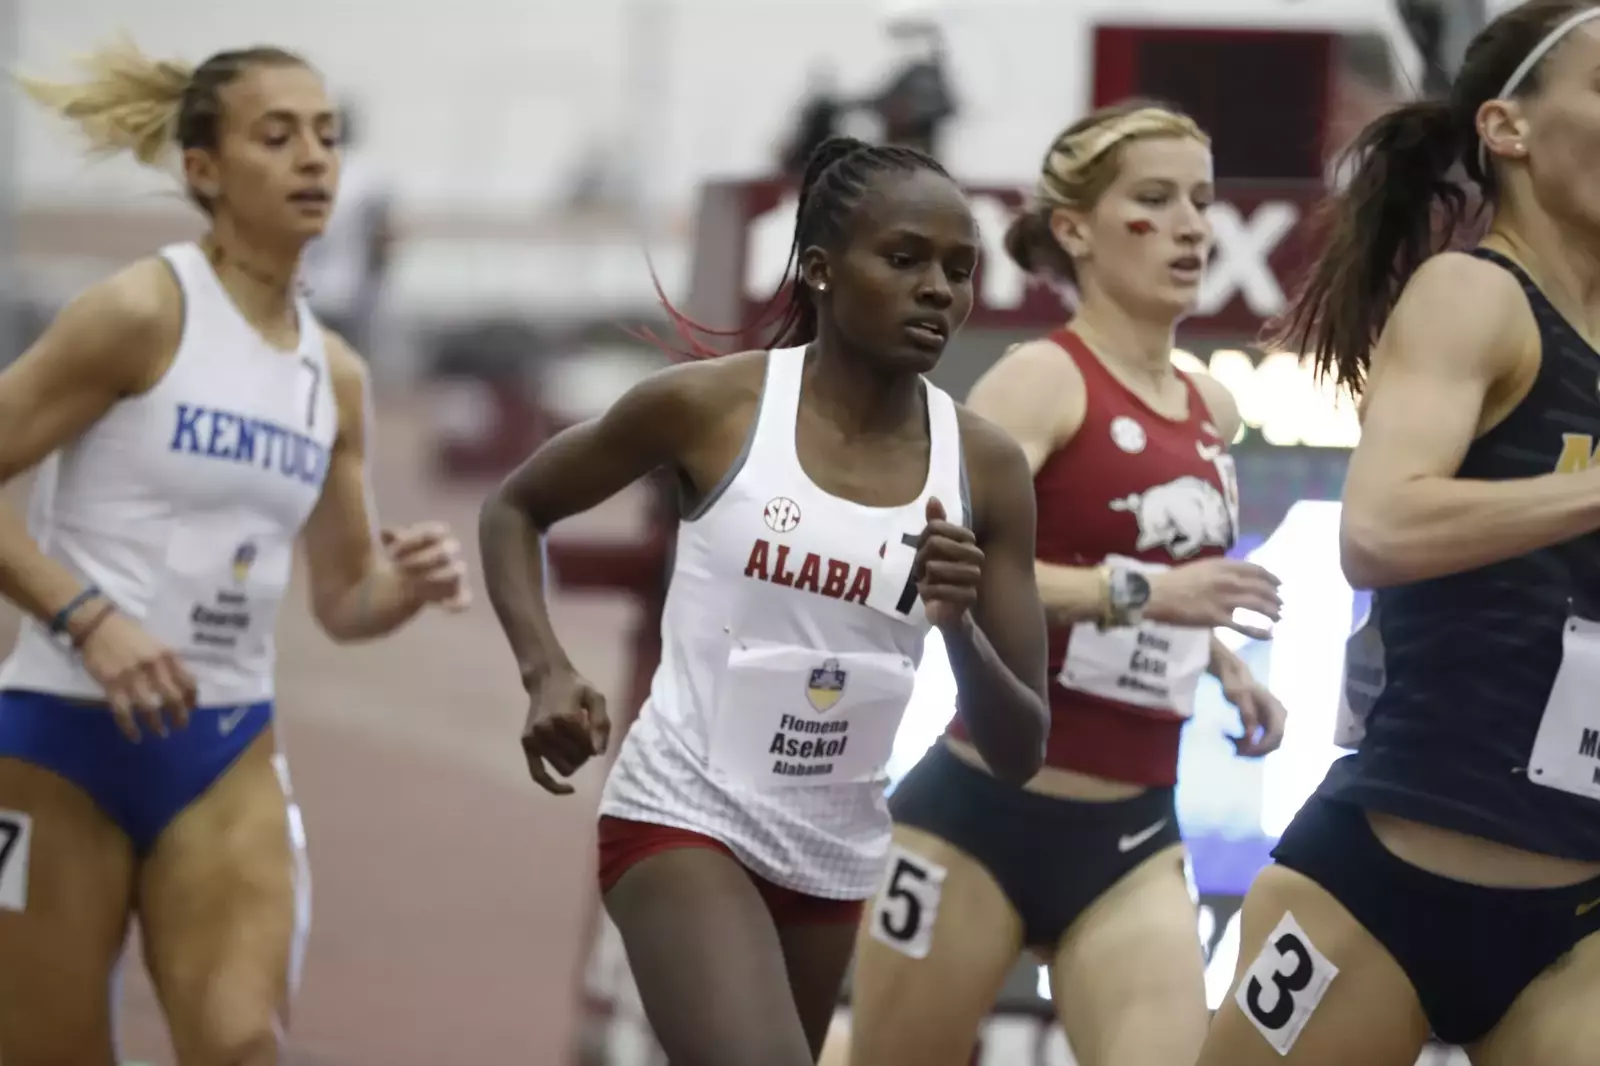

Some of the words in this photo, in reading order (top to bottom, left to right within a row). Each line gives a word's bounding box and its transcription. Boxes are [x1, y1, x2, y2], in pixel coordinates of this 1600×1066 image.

[171, 403, 327, 484] KENTUC
[765, 498, 801, 532] SEC
[744, 538, 873, 605] ALABA
[769, 732, 848, 758] Asekol
[780, 713, 849, 734] Flomena
[773, 760, 834, 777] Alabama
[882, 858, 927, 942] 5
[1247, 933, 1313, 1029] 3
